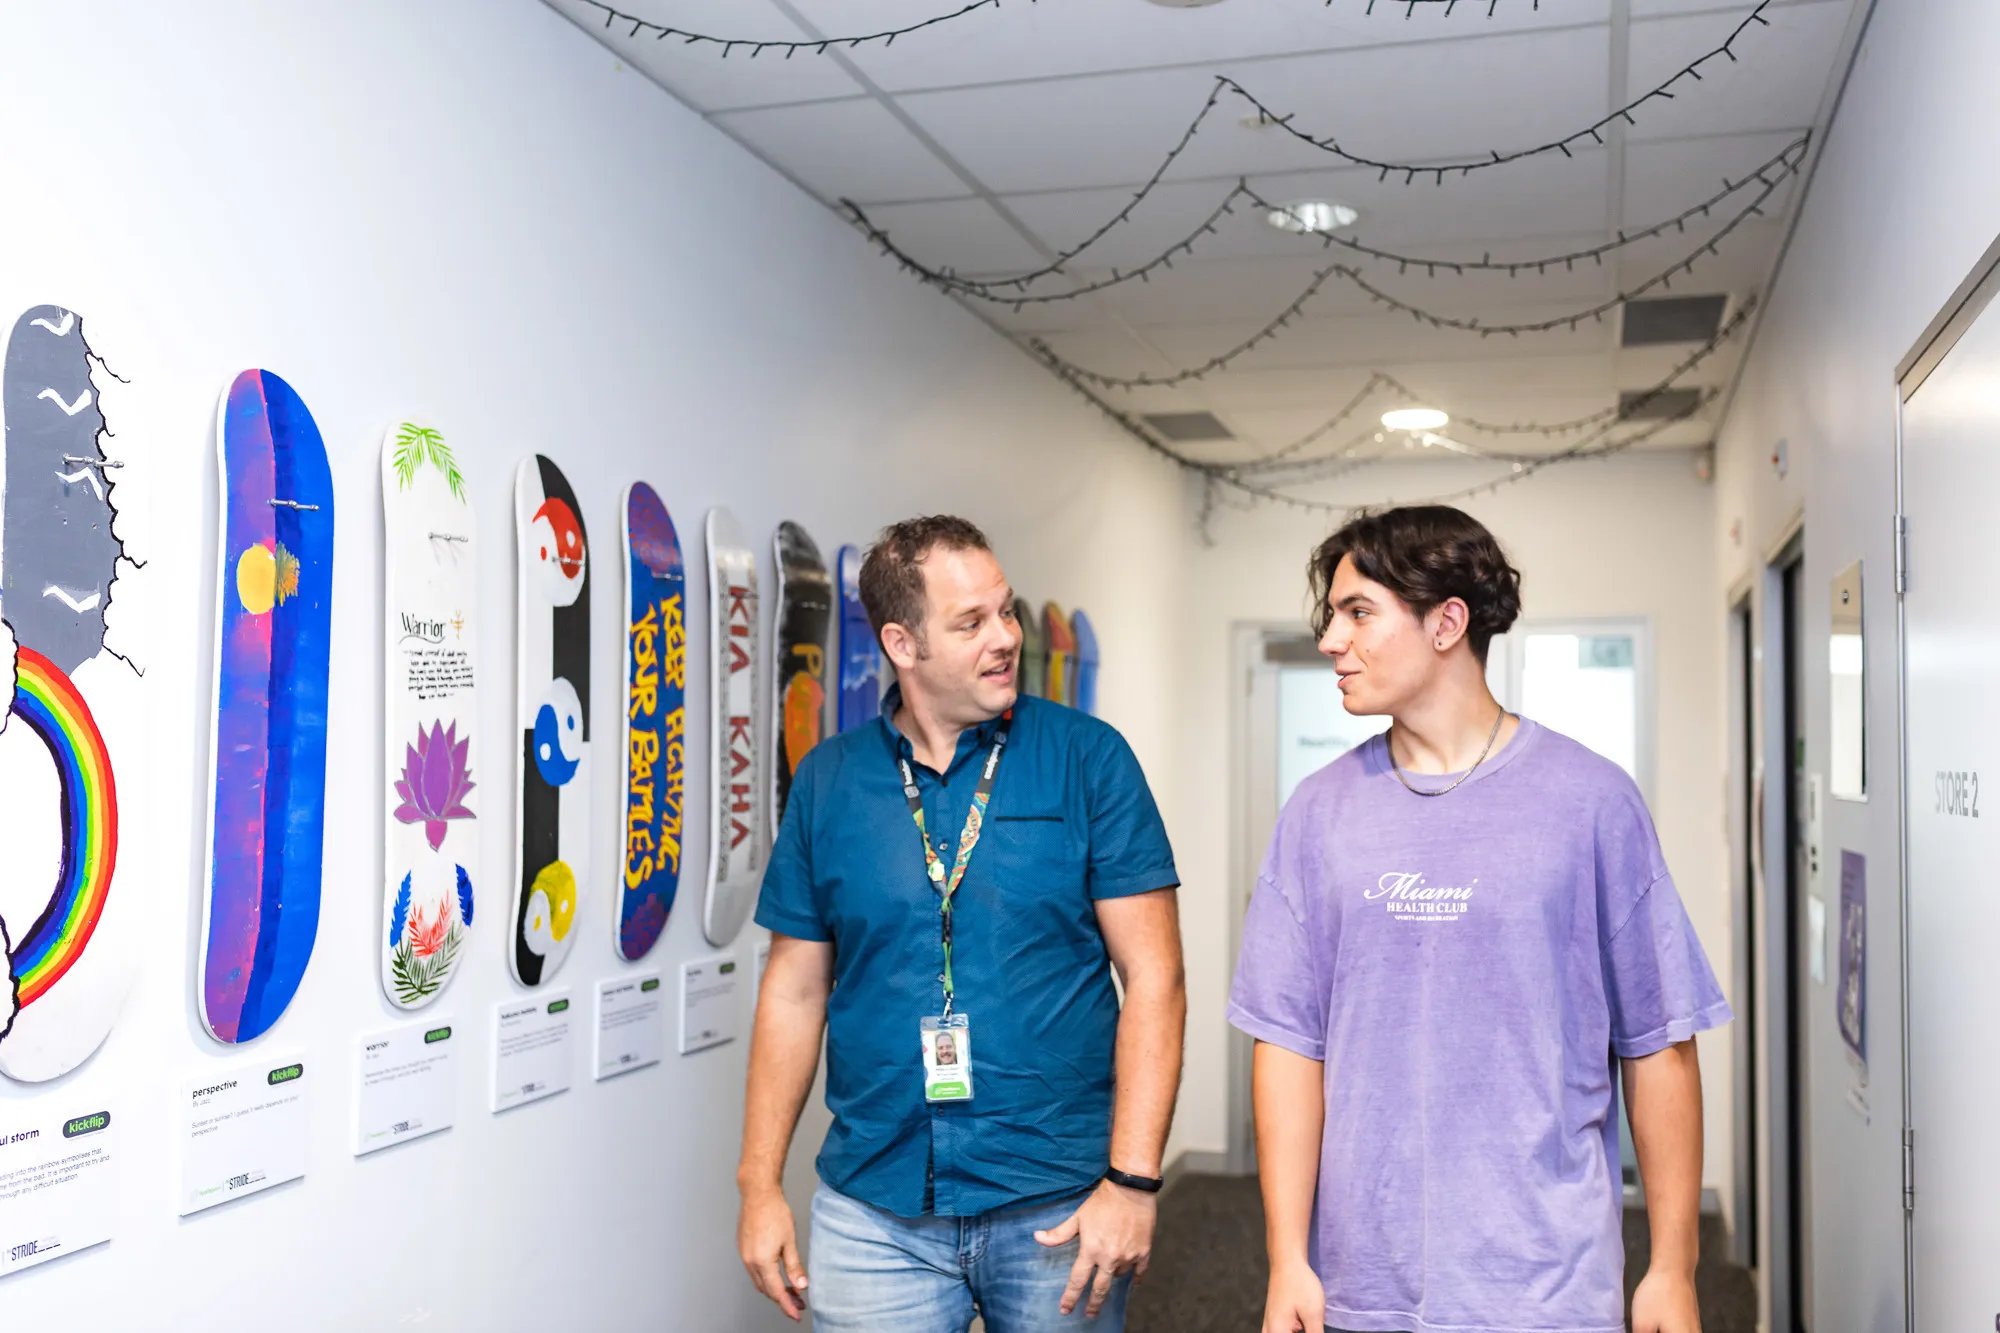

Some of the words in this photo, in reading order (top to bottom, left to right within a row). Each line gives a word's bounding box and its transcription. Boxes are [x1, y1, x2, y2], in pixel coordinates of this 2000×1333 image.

[401, 611, 447, 638] Warrior
[729, 585, 751, 675] KIA
[658, 591, 686, 690] KEEP
[629, 601, 660, 721] YOUR
[729, 716, 751, 851] KAHA
[1935, 770, 1968, 816] STORE
[1972, 771, 1979, 818] 2
[1363, 871, 1479, 900] Miami
[1386, 902, 1434, 913] HEALTH
[1436, 902, 1468, 913] CLUB
[272, 1066, 300, 1082] kickflip
[192, 1080, 238, 1100] perspective
[69, 1116, 105, 1134] kickflip
[11, 1130, 40, 1144] storm
[38, 1160, 60, 1172] rainbow
[61, 1151, 90, 1166] symbolises
[59, 1160, 84, 1174] important
[34, 1178, 54, 1192] difficult
[228, 1172, 250, 1190] STRIDE
[12, 1240, 38, 1262] STRIDE
